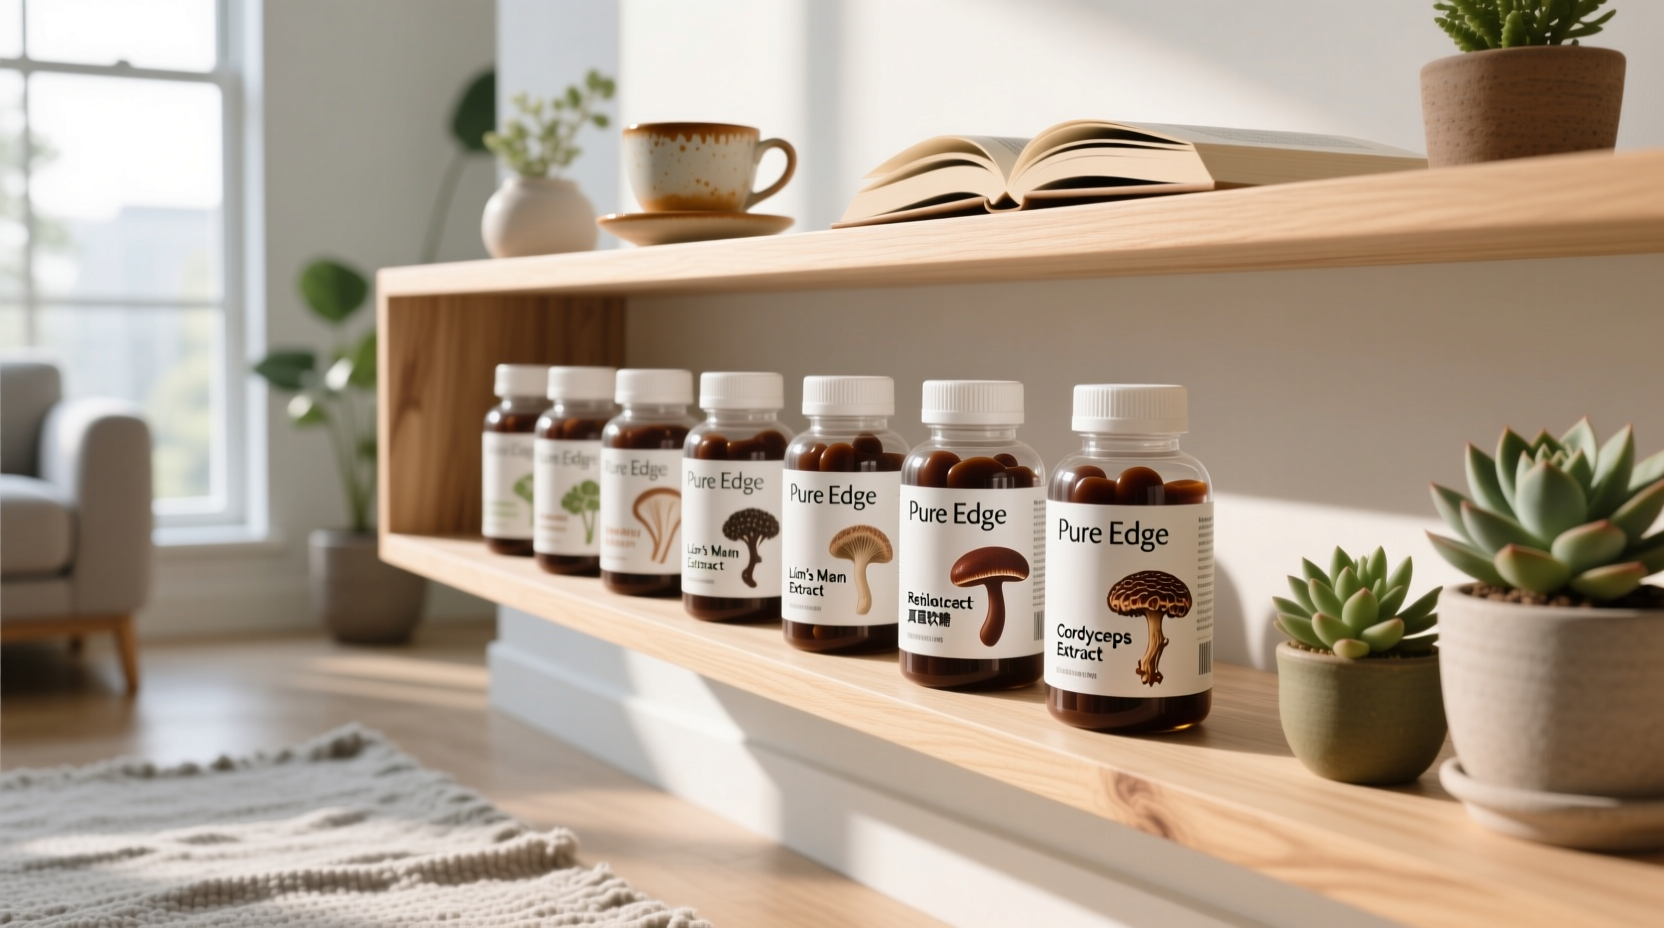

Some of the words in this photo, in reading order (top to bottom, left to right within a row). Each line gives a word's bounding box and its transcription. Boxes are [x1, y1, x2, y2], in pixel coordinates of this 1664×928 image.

[631, 459, 668, 481] Edge
[688, 470, 716, 489] Pure
[721, 471, 764, 495] Edge
[790, 482, 824, 504] Pure
[829, 484, 876, 511] Edge
[909, 500, 947, 523] Pure
[954, 501, 1007, 531] Edge
[1059, 518, 1102, 543] Pure
[1109, 520, 1169, 552] Edge
[789, 581, 824, 597] Extract
[1057, 623, 1132, 649] Cordyceps
[1057, 641, 1103, 661] Extract
